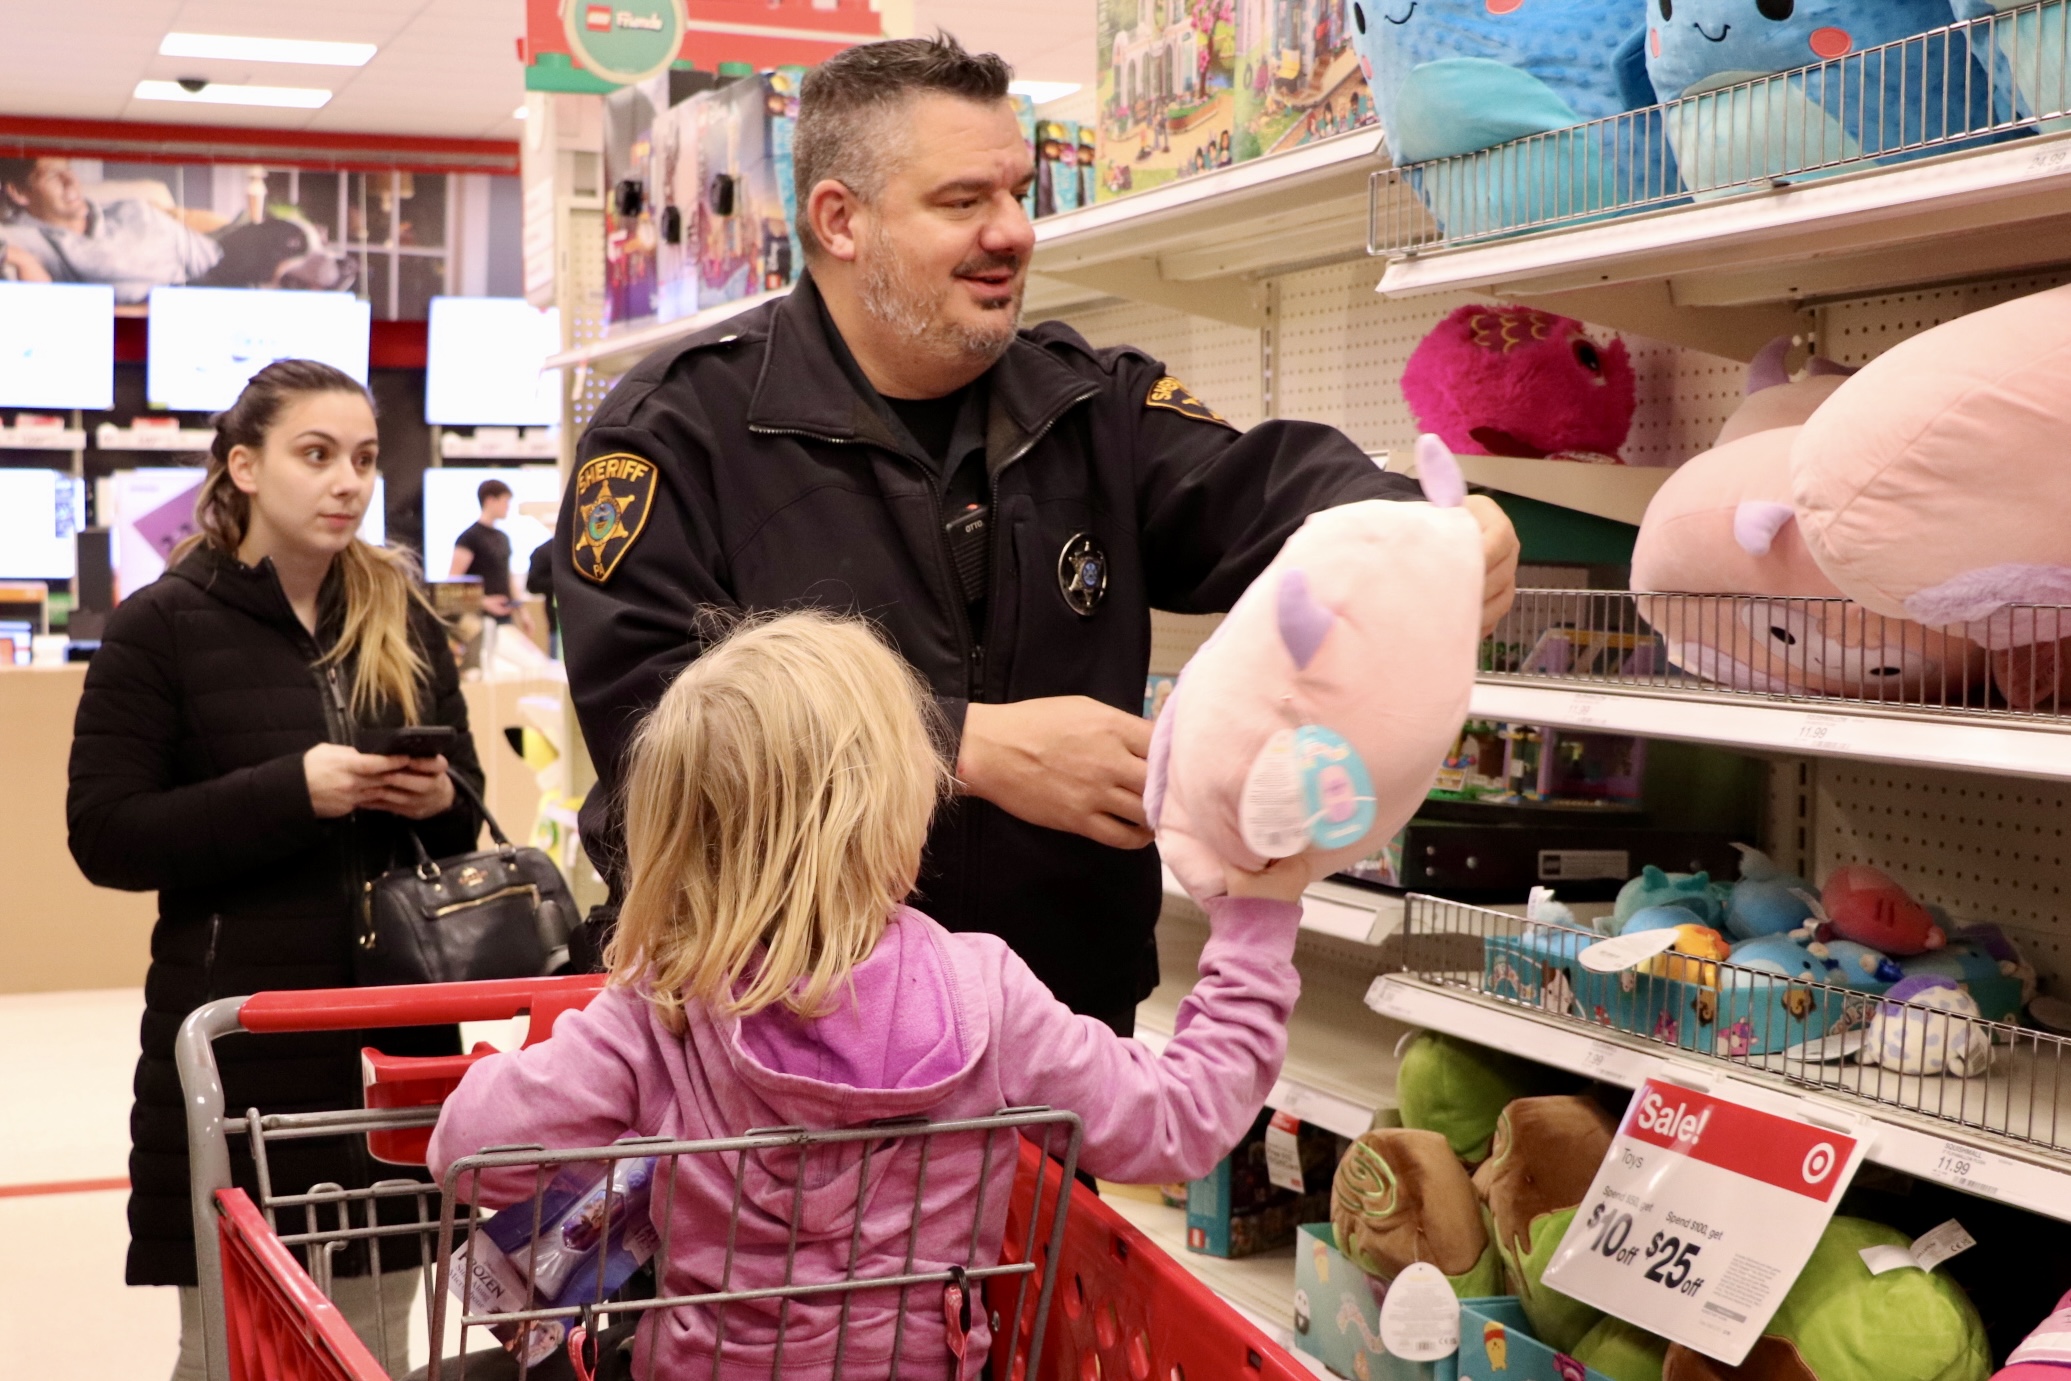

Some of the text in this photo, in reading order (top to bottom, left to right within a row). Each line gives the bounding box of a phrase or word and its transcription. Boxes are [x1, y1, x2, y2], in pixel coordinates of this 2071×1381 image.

[579, 459, 650, 495] SHERIFF
[965, 519, 983, 533] OTTO
[593, 562, 606, 577] PA
[1800, 726, 1828, 739] 11.99
[1638, 1092, 1710, 1146] Sale!
[1622, 1148, 1644, 1170] Toys
[1938, 1155, 1971, 1176] 11.99
[1602, 1185, 1626, 1202] Spend
[1640, 1201, 1654, 1213] get
[1587, 1201, 1640, 1266] $10 off
[1665, 1210, 1692, 1230] Spend
[1707, 1229, 1724, 1241] get
[1643, 1229, 1705, 1297] $25 off
